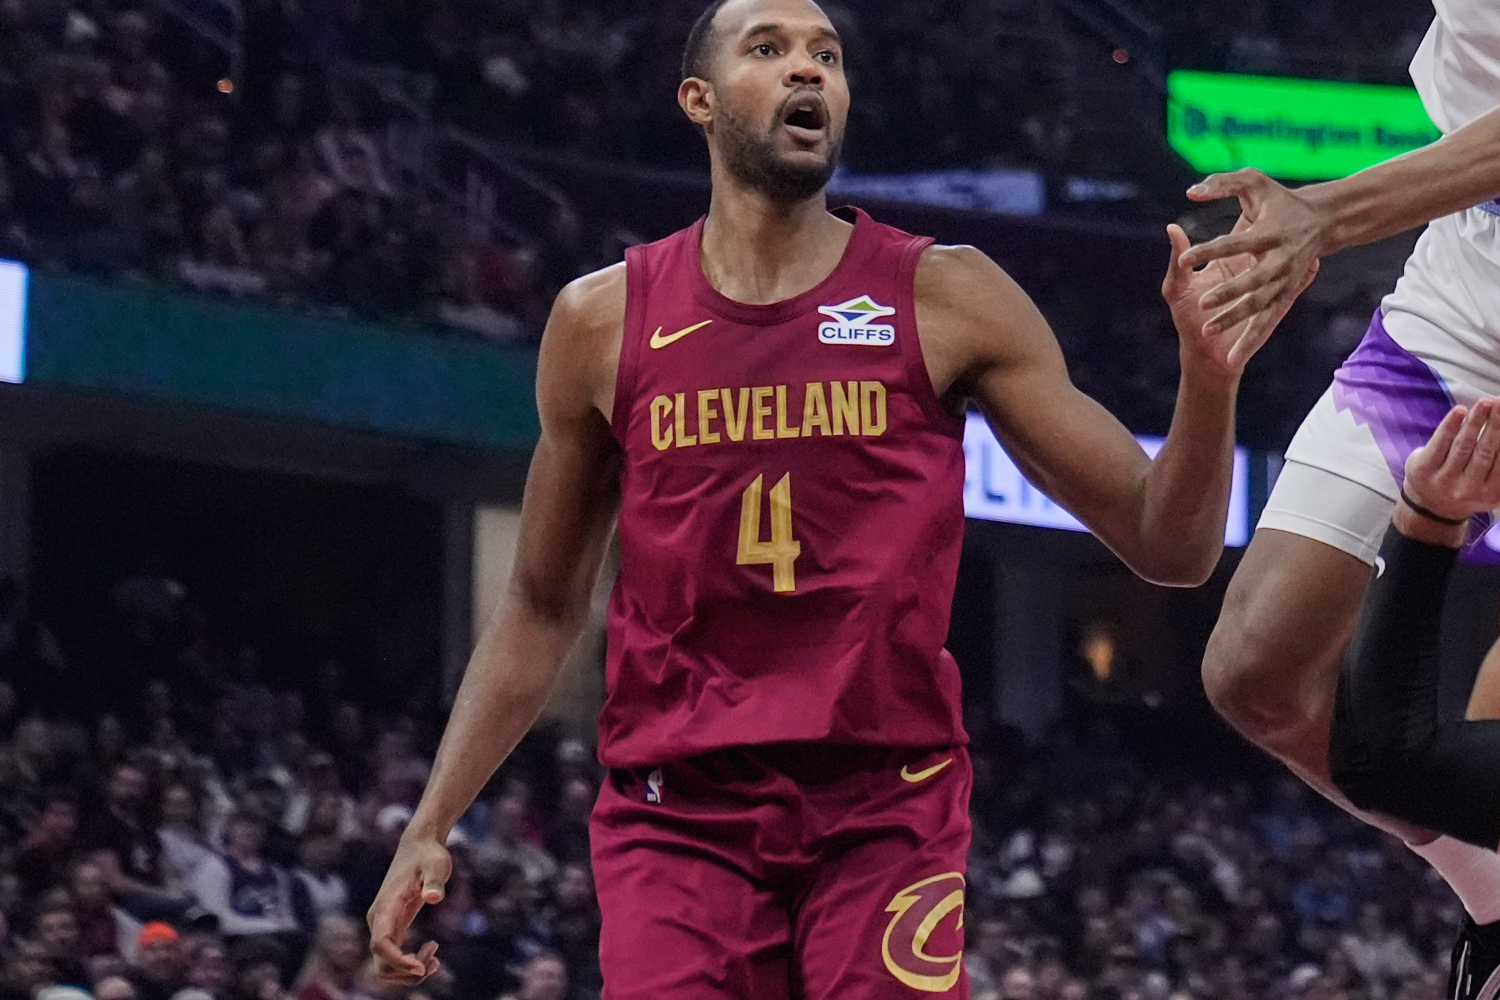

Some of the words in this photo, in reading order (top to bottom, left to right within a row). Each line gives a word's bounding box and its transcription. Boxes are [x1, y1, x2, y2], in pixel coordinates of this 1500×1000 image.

[821, 326, 892, 341] CLIFFS
[649, 380, 888, 451] CLEVELAND
[735, 470, 801, 592] 4
